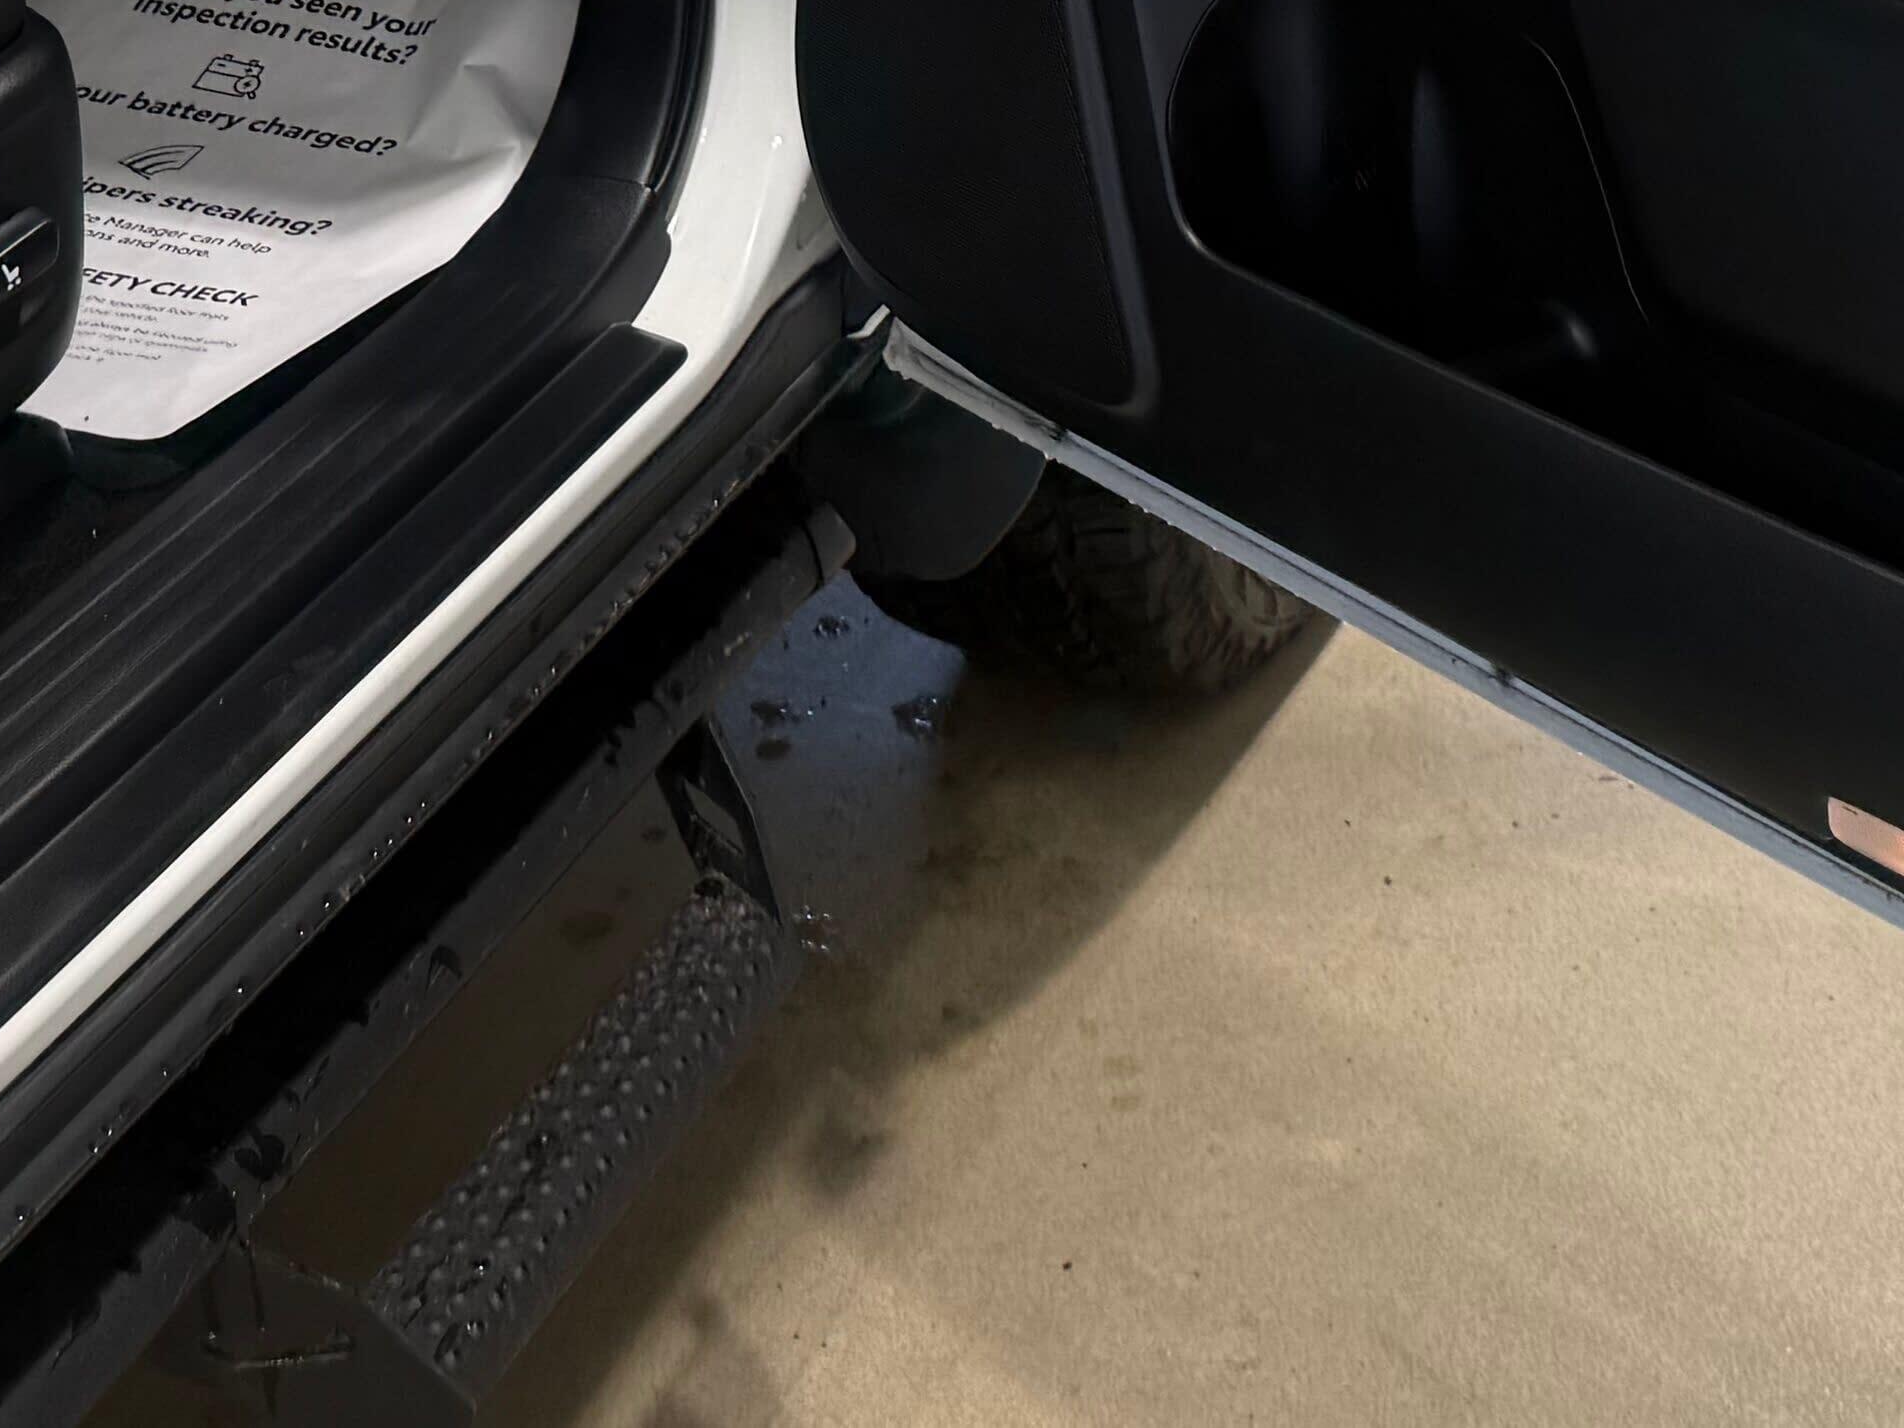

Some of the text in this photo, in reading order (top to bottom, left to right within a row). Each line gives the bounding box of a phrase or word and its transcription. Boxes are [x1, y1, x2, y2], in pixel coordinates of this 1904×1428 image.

[363, 11, 437, 37] your
[294, 27, 418, 65] results?
[127, 90, 246, 132] battery
[247, 116, 398, 157] charged?
[158, 195, 334, 236] streaking?
[102, 215, 188, 240] Manager
[189, 233, 225, 247] can
[227, 238, 272, 255] help
[117, 236, 158, 250] and
[158, 243, 211, 259] more.
[150, 281, 259, 307] CHECK
